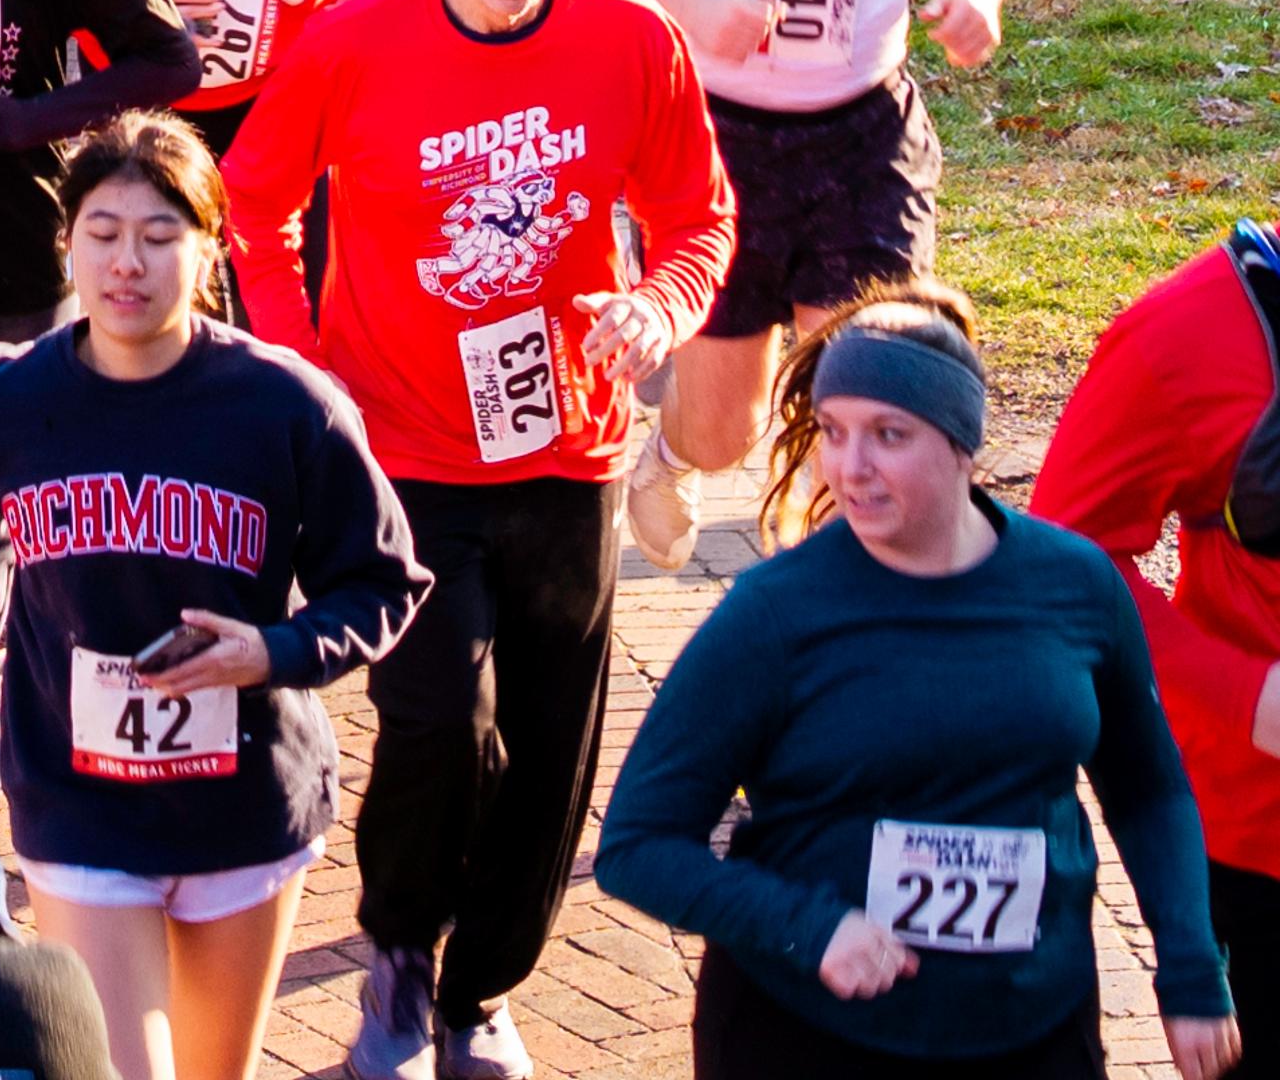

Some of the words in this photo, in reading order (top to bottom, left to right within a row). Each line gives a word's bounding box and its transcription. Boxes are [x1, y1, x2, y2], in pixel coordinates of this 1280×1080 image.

[419, 105, 549, 170] SPIDER
[489, 123, 585, 181] DASH
[422, 166, 473, 188] UNIVERSITY
[475, 162, 486, 173] OF
[441, 171, 487, 192] RICHMOND
[552, 318, 567, 356] TICKET
[484, 373, 505, 414] DASH
[497, 330, 555, 434] 293
[557, 361, 571, 386] MEAL
[474, 389, 496, 441] SPIDER
[560, 389, 575, 411] HDC
[0, 472, 267, 579] RICHMOND
[115, 694, 192, 755] 42
[128, 758, 167, 778] MEAL
[170, 757, 219, 775] TICKET
[892, 871, 1020, 943] 227
